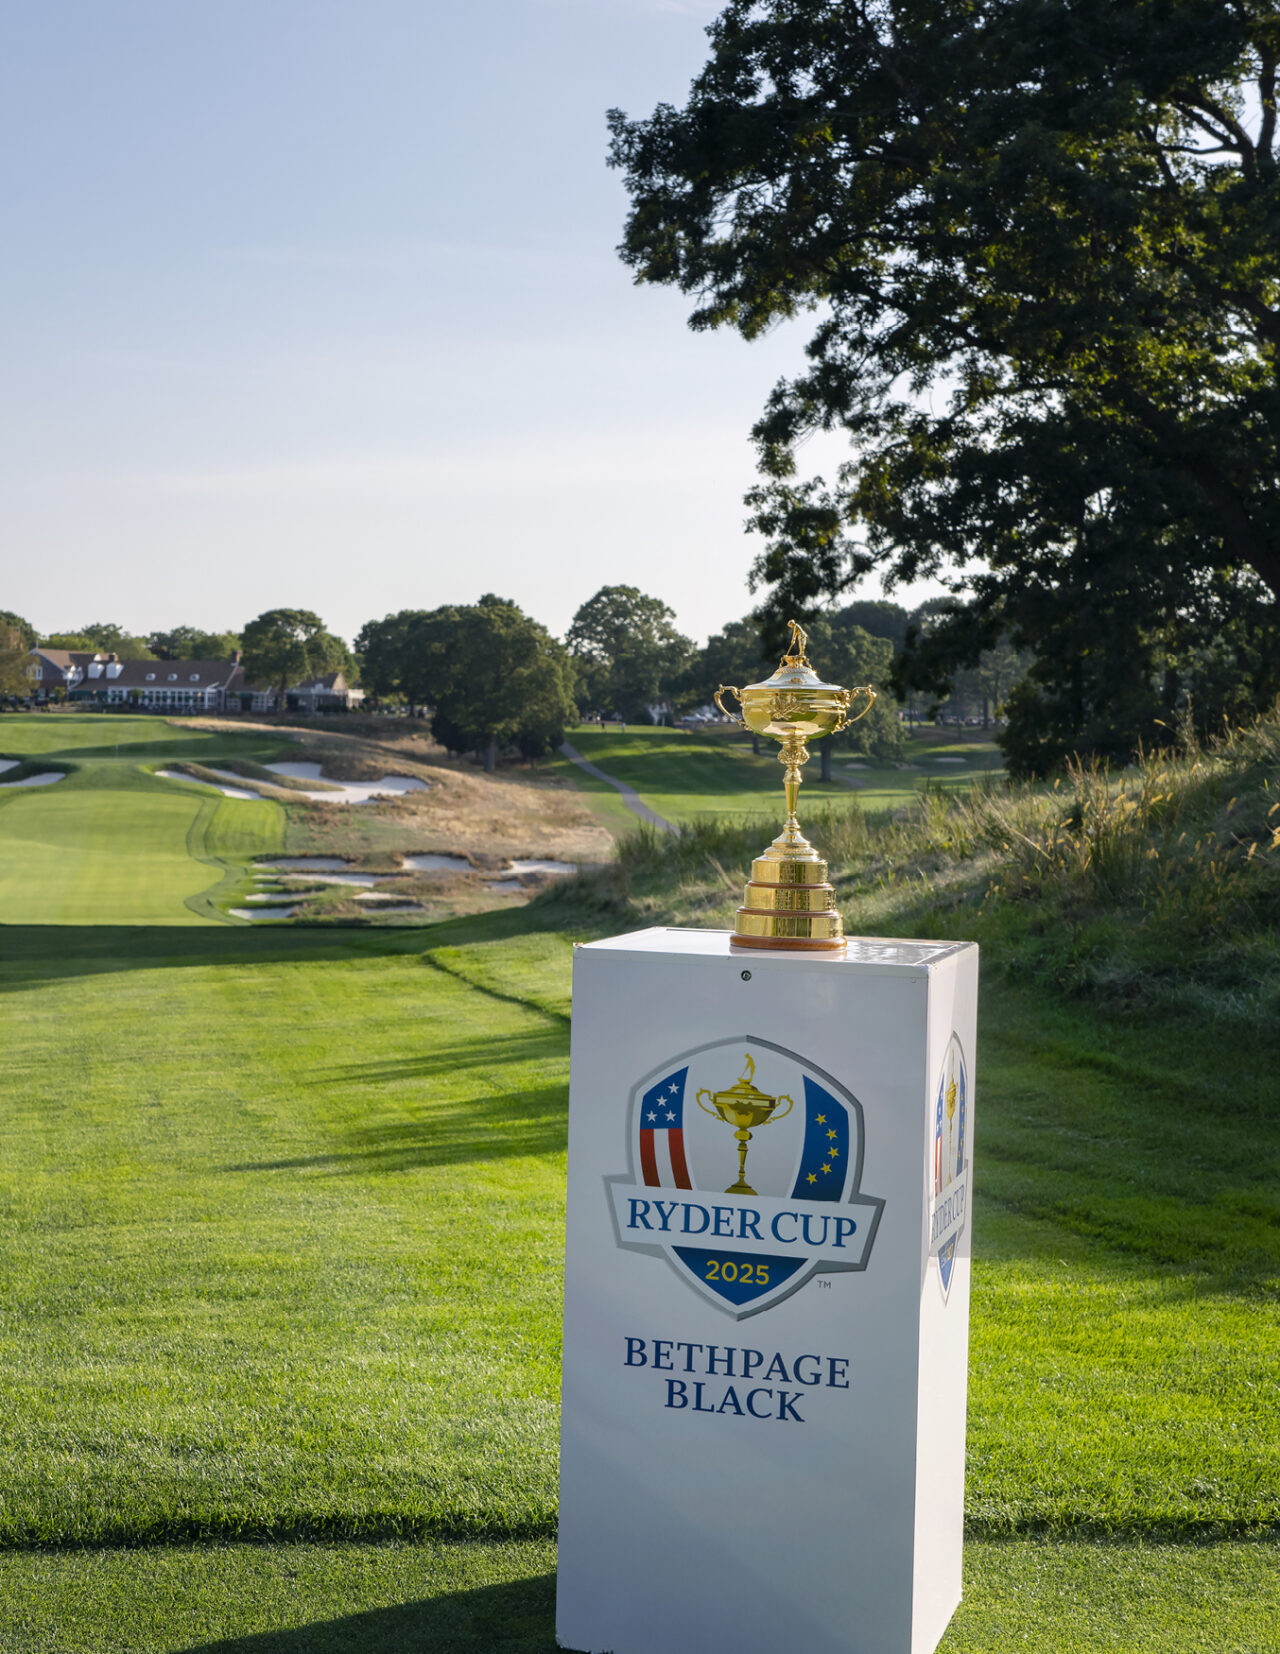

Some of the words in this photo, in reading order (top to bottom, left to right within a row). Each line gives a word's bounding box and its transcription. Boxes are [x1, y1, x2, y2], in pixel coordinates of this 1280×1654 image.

[626, 1198, 765, 1241] RYDER
[771, 1211, 858, 1249] CUP
[705, 1260, 770, 1286] 2025
[623, 1336, 851, 1389] BETHPAGE
[664, 1378, 806, 1423] BLACK
